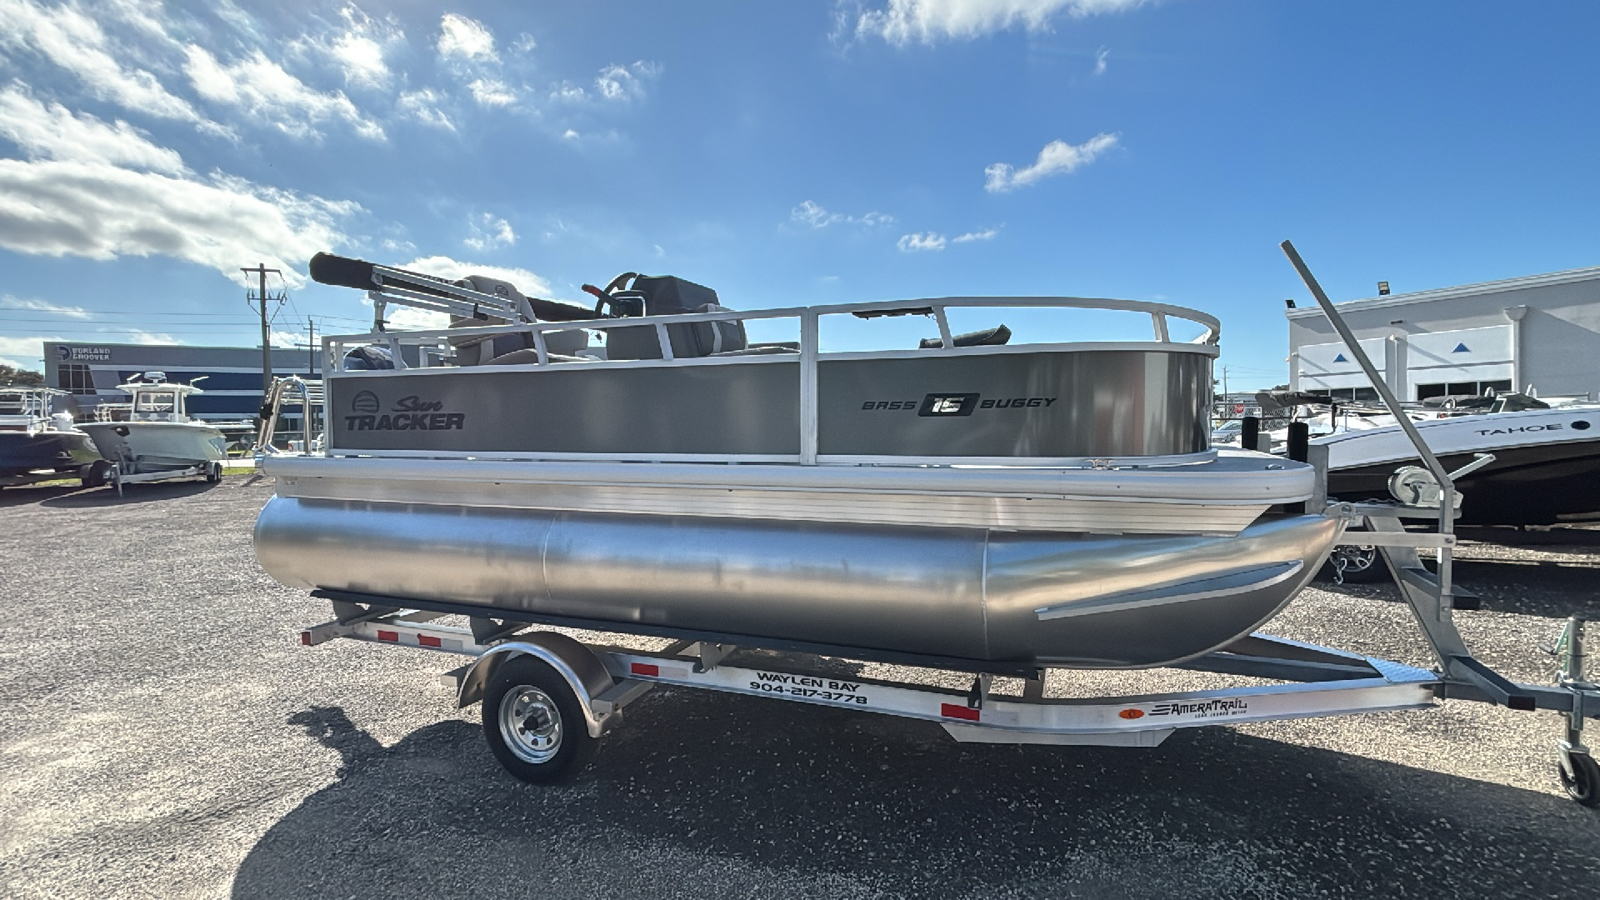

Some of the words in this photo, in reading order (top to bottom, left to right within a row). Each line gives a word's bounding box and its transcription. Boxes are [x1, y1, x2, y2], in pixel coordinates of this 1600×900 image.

[391, 395, 443, 412] Sun
[862, 401, 917, 410] BASS
[980, 398, 1057, 408] BUGGY
[345, 413, 465, 430] TRACKER
[1475, 423, 1563, 435] TAHOE
[757, 672, 823, 688] WAYLEN
[828, 681, 860, 692] BAY
[750, 681, 868, 704] 904-217-3778
